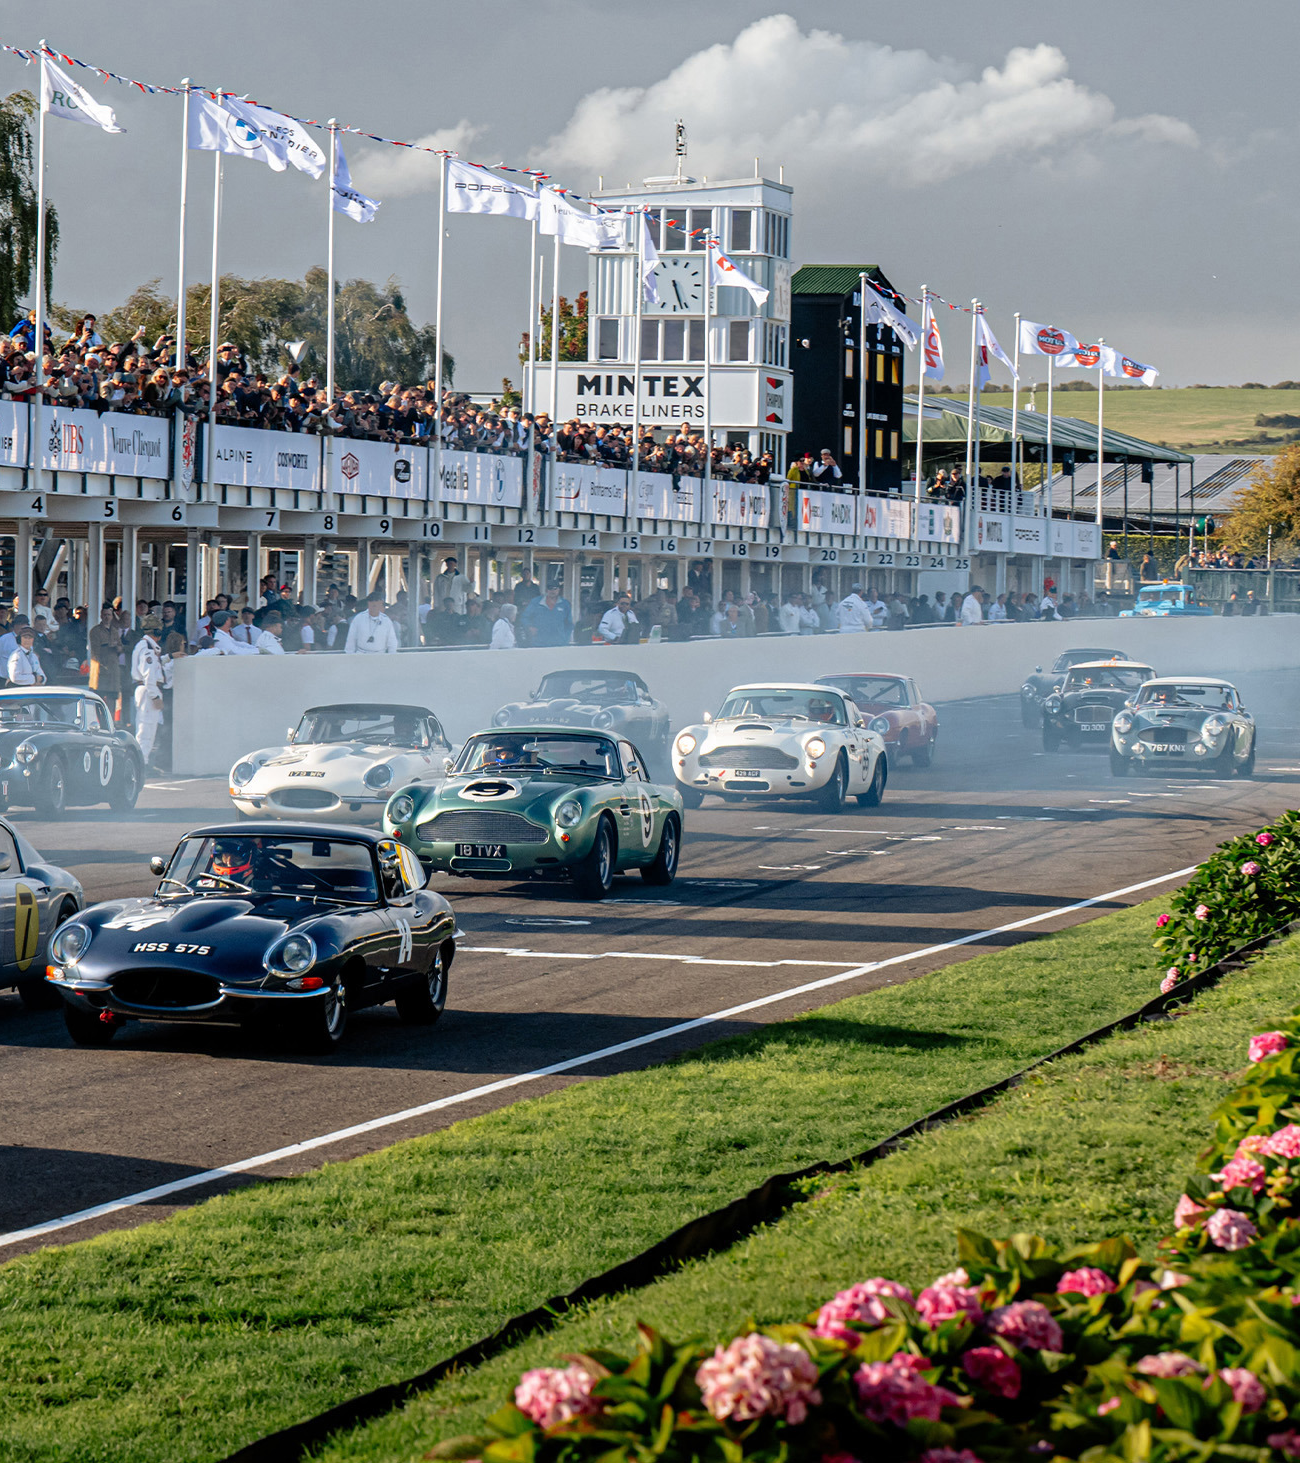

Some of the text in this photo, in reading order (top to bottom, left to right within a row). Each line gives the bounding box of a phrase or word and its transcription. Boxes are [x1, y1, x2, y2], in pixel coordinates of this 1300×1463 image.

[577, 374, 705, 398] MINTEX
[576, 403, 705, 418] BRAKE LINERS
[63, 424, 84, 454] UBS
[111, 426, 132, 455] Veuve
[132, 429, 162, 463] Clicquot
[216, 449, 252, 464] ALPINE
[277, 452, 308, 469] COSWORTH
[31, 496, 43, 513] 4
[104, 501, 114, 517] 5
[172, 506, 182, 521] 6
[266, 512, 275, 527] 7
[324, 515, 334, 530] 8
[380, 519, 389, 534] 9
[423, 523, 440, 537] 10
[474, 526, 488, 540] 11
[518, 529, 534, 543] 12
[582, 533, 597, 546] 14
[623, 536, 638, 549] 15
[661, 539, 675, 551] 16
[698, 541, 711, 553] 17
[732, 544, 746, 556] 18
[766, 546, 779, 558] 19
[822, 550, 836, 561] 20
[852, 553, 865, 563] 21
[878, 554, 893, 565] 22
[906, 556, 919, 566] 23
[930, 558, 944, 568] 24
[956, 559, 969, 569] 25
[1152, 744, 1185, 752] 767 KNX
[641, 794, 651, 839] 9
[459, 845, 502, 857] 18 TVX
[20, 893, 34, 960] 7
[133, 942, 211, 955] HSS 575
